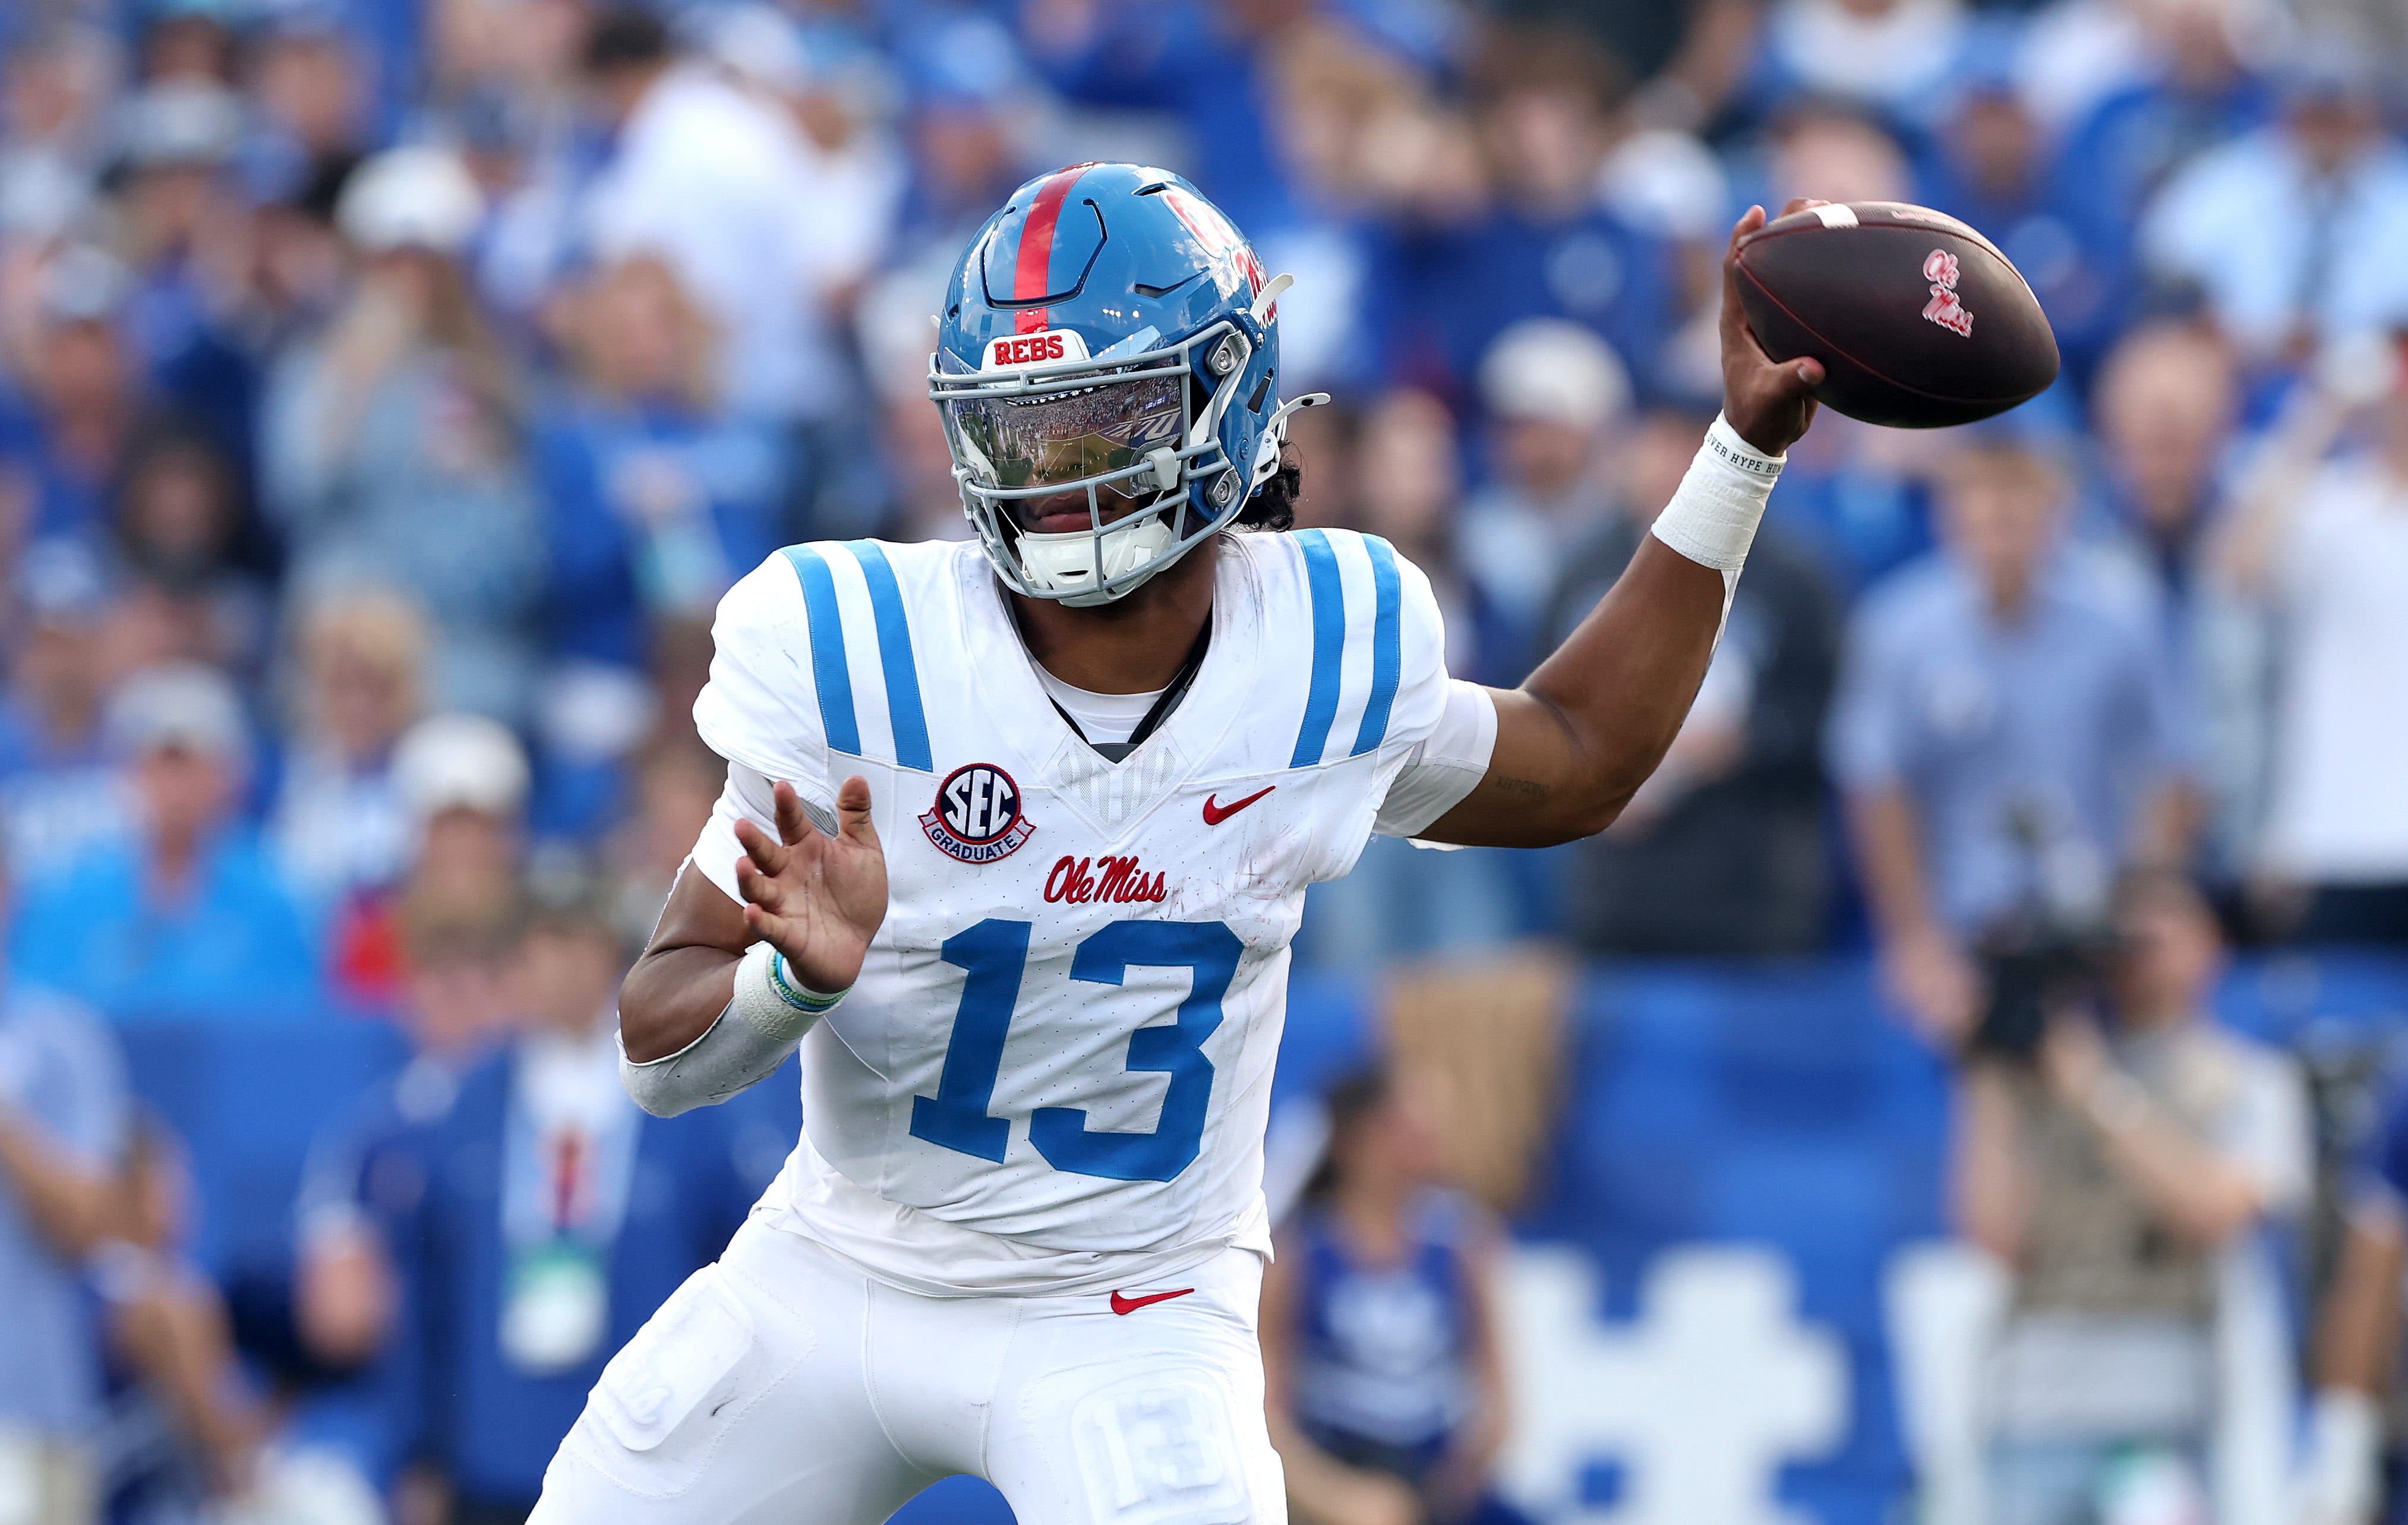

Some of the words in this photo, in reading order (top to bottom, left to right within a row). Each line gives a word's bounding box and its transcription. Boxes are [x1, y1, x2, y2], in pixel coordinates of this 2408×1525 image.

[1923, 249, 1960, 289] Ole
[994, 335, 1063, 365] REBS
[1707, 433, 1728, 457] OVER
[1730, 453, 1762, 471] HYPE
[945, 769, 1013, 837] SEC
[931, 828, 1018, 860] GRADUATE
[1044, 855, 1094, 904] Ole
[1093, 856, 1167, 903] Miss
[910, 918, 1244, 1183] 13
